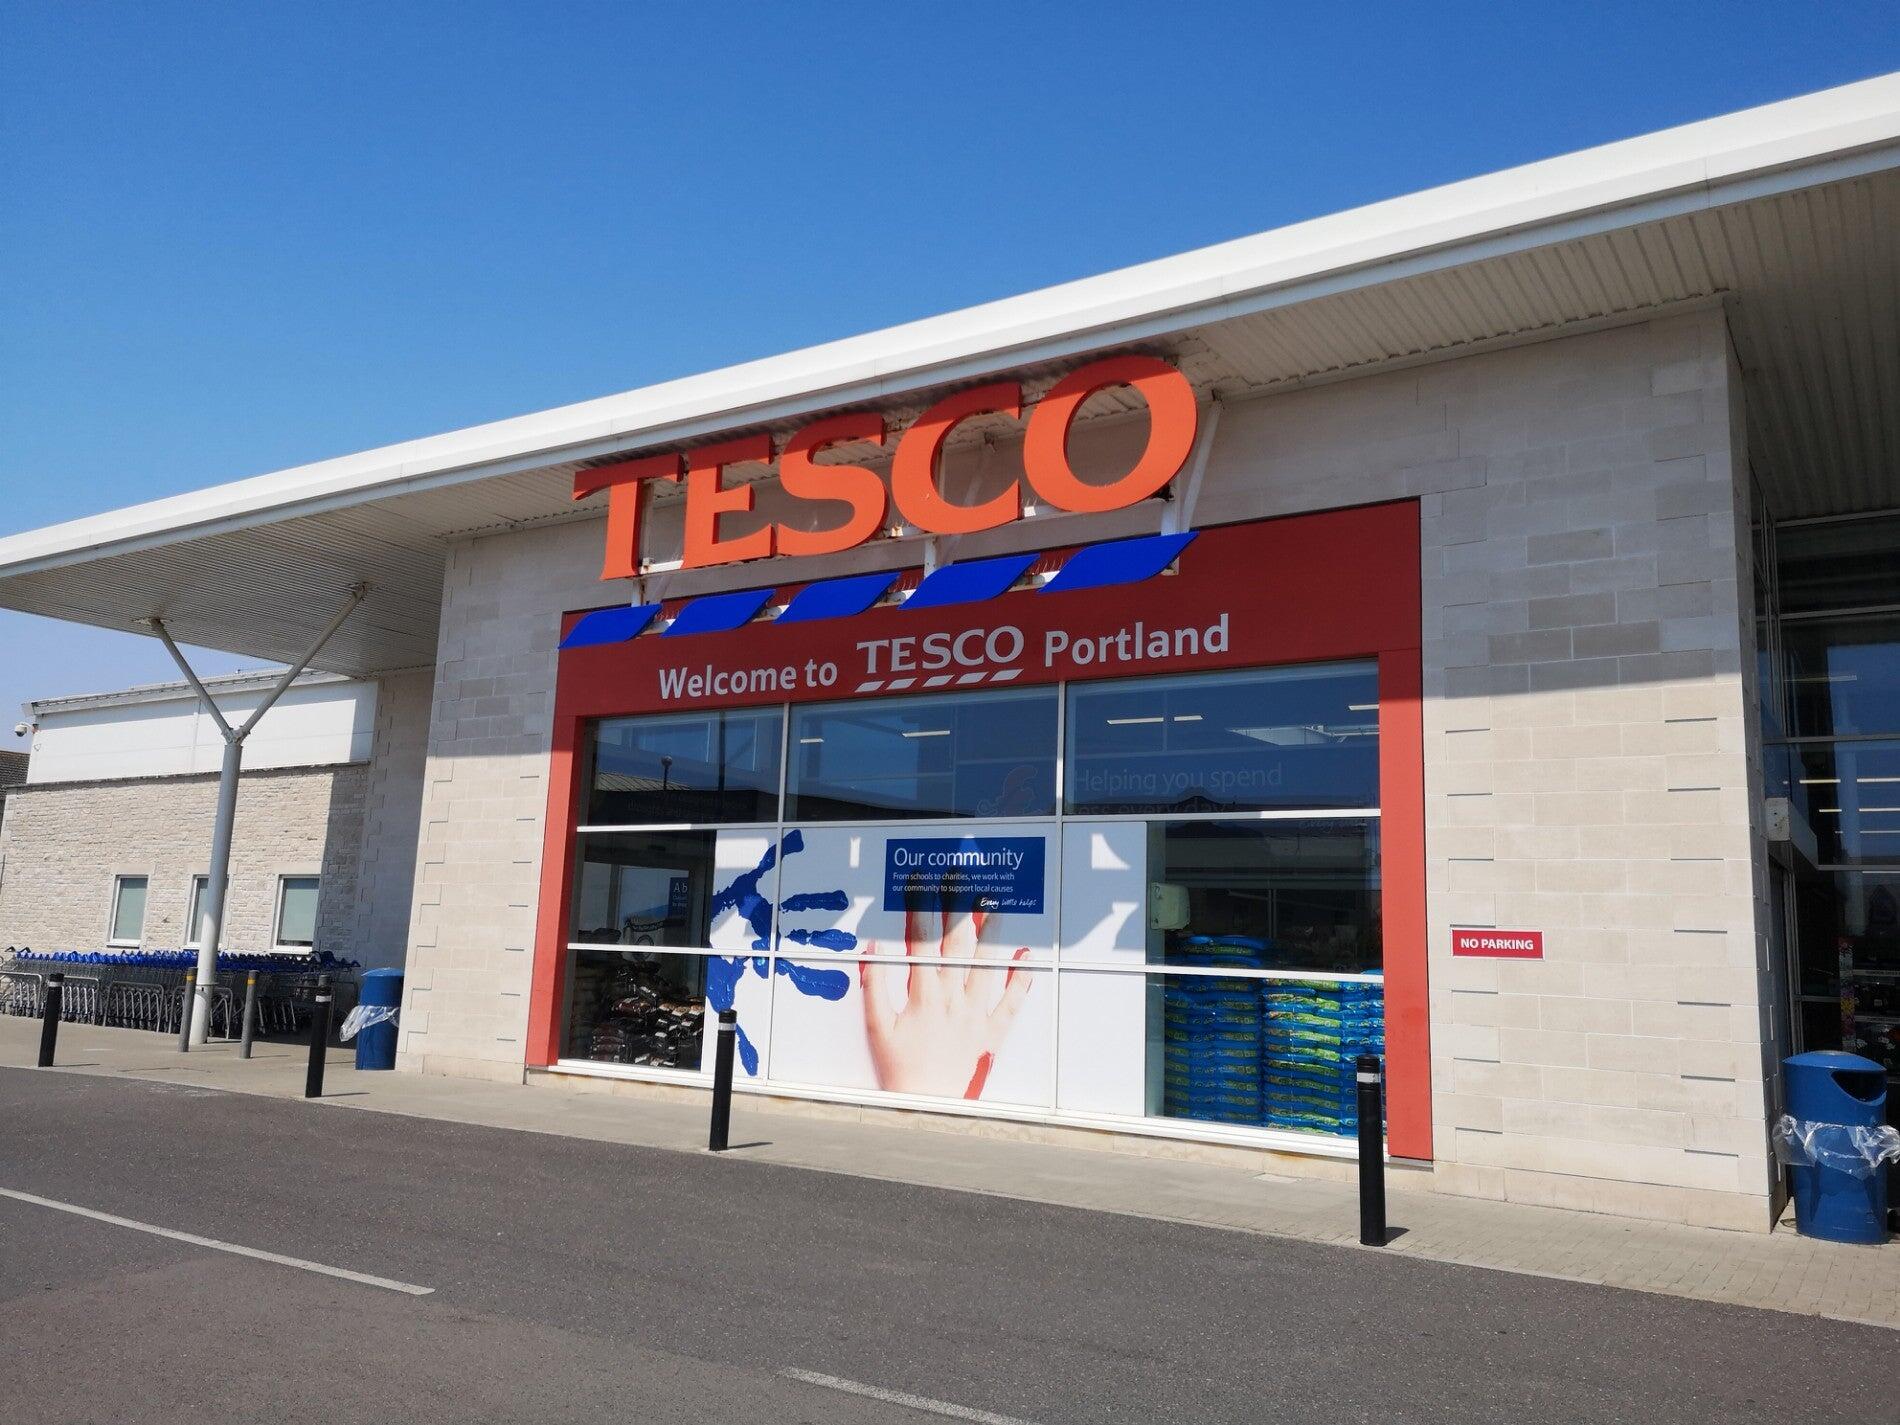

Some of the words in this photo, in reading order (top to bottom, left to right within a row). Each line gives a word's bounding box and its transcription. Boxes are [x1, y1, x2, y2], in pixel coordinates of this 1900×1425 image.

[573, 354, 1197, 582] TESCO
[658, 664, 797, 700] Welcome
[804, 658, 838, 688] to
[856, 625, 1025, 674] TESCO
[1045, 613, 1229, 668] Portland
[1074, 767, 1155, 796] Helping
[1161, 771, 1204, 794] you
[1207, 761, 1283, 792] spend
[893, 847, 925, 867] Our
[928, 847, 1025, 871] community
[892, 872, 910, 880] From
[910, 872, 934, 881] schools
[934, 872, 941, 881] to
[941, 872, 971, 882] charities,
[982, 872, 999, 881] work
[1000, 872, 1015, 881] with
[904, 884, 940, 894] community
[948, 885, 974, 894] support
[974, 884, 991, 893] local
[1460, 937, 1479, 949] NO
[1481, 938, 1534, 950] PARKING
